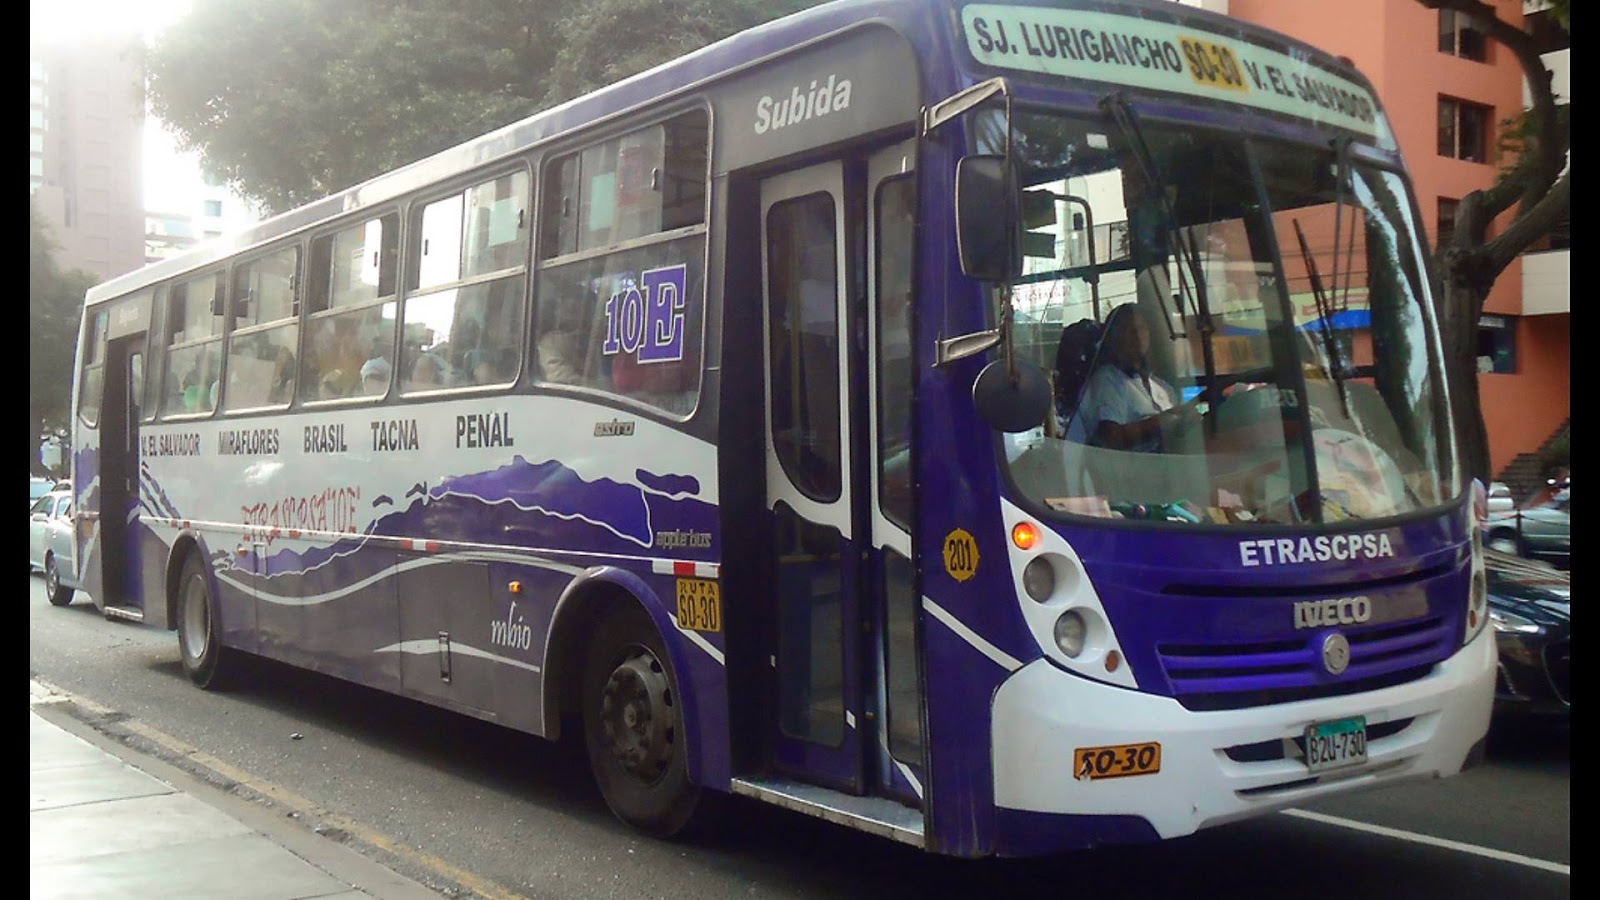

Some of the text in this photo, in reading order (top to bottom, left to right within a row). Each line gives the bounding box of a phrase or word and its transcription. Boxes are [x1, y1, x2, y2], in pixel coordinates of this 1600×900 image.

[973, 16, 1376, 125] SJ. LURIGANCHO SO-30 V. EL SALVADOR
[754, 74, 852, 135] Subida
[603, 263, 687, 364] 10E
[149, 435, 157, 456] EL
[159, 432, 200, 456] SALVADOR
[218, 428, 279, 455] MIRAFLORES
[304, 424, 348, 453] BRASIL
[371, 419, 419, 452] TACNA
[456, 412, 514, 448] PENAL
[949, 538, 972, 571] 201
[1239, 533, 1394, 568] ETRASCPSA
[679, 582, 716, 596] RUTA
[679, 595, 717, 629] SO-30
[1294, 595, 1371, 630] IVECO
[1081, 745, 1156, 776] SO-30
[1310, 730, 1365, 764] B2U-730
